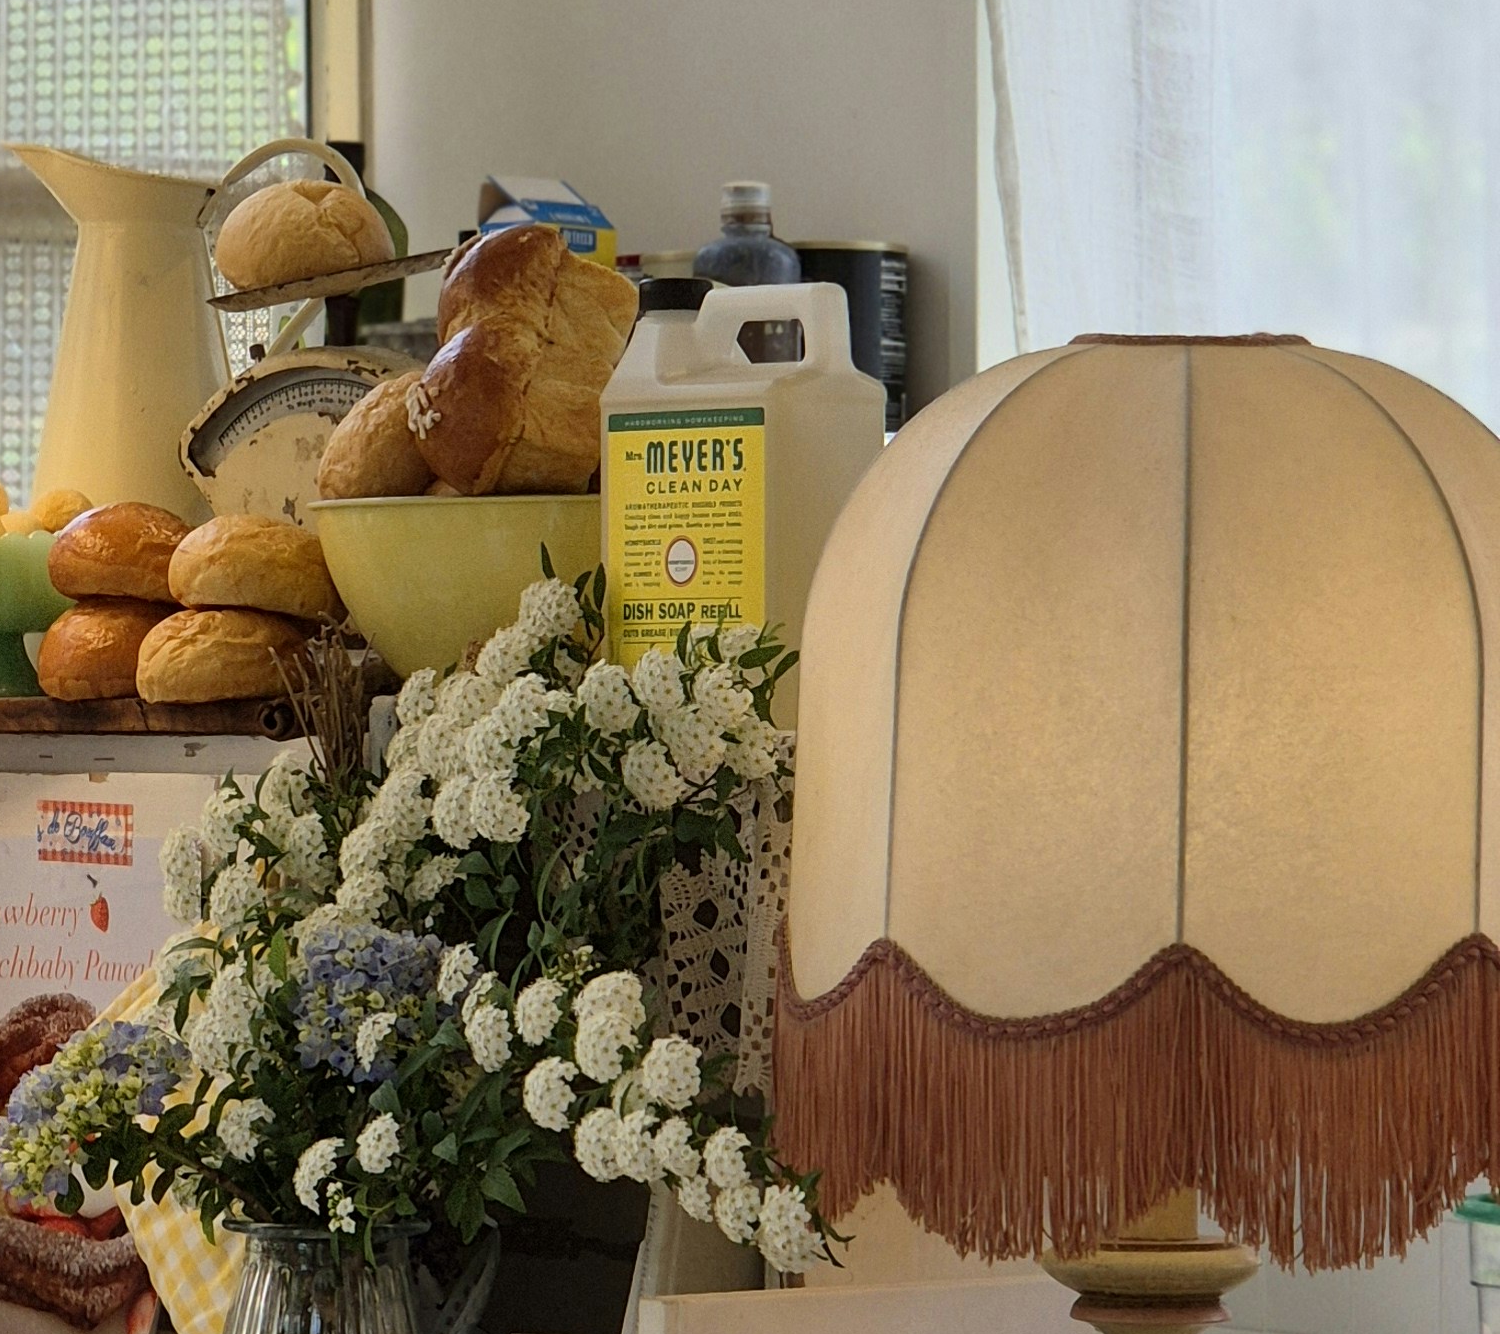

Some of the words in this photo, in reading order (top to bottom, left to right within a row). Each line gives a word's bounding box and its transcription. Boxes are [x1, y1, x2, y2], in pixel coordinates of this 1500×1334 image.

[646, 479, 702, 495] CLEAN
[708, 478, 743, 492] DAY
[623, 603, 654, 621] DISH
[658, 602, 696, 620] SOAP
[701, 604, 742, 619] REFILL
